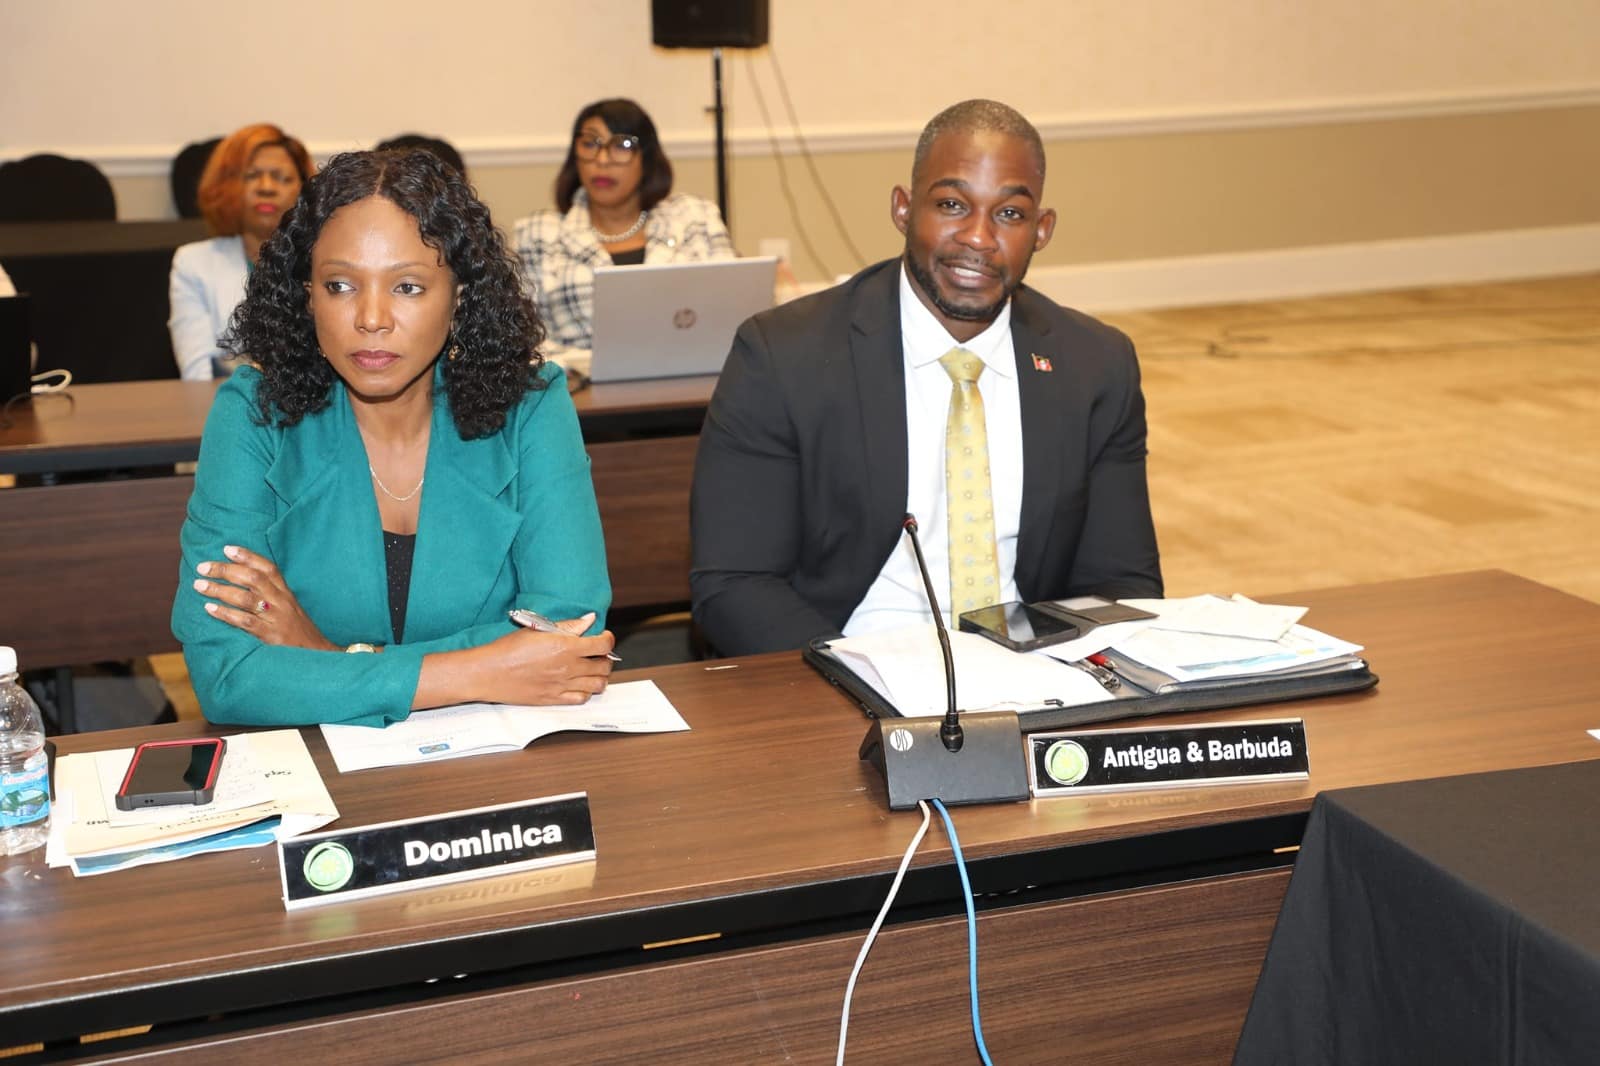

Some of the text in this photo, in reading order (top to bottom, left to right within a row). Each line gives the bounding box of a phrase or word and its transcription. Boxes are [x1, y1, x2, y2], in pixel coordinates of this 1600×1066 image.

[1103, 736, 1293, 771] Antigua & Barbuda
[404, 824, 562, 866] Dominica
